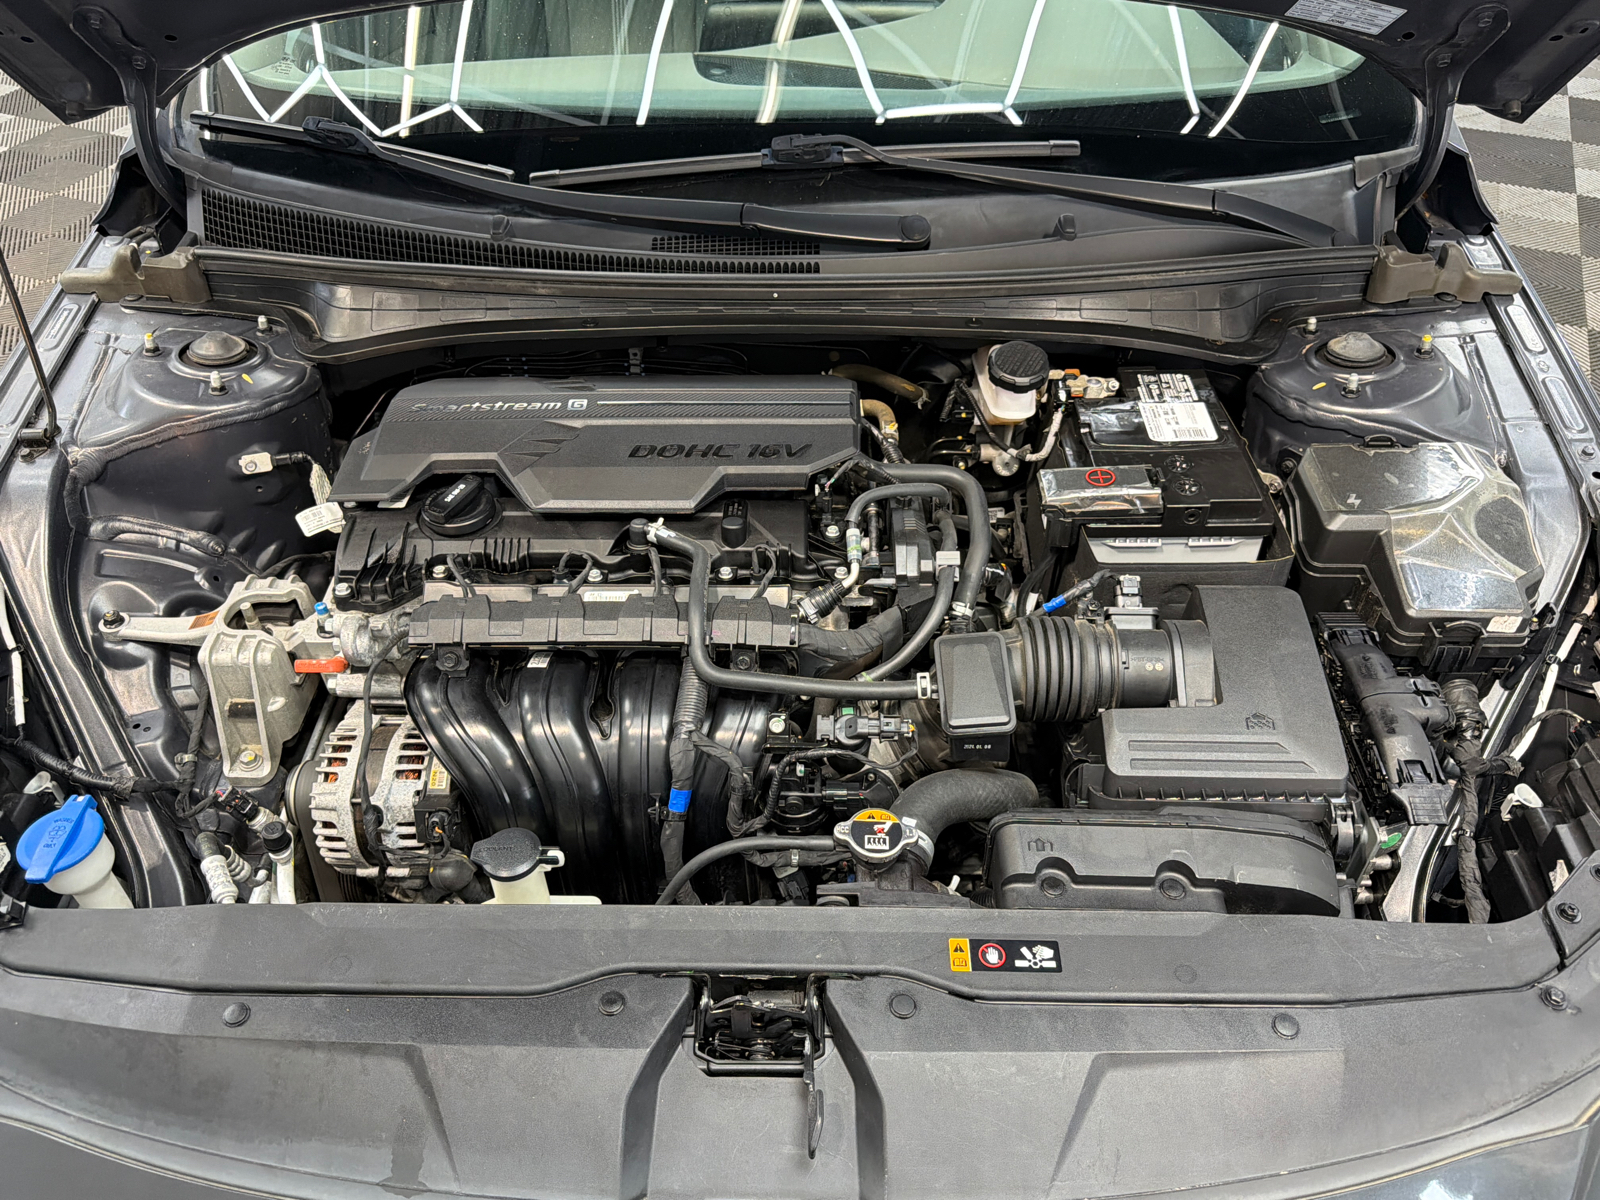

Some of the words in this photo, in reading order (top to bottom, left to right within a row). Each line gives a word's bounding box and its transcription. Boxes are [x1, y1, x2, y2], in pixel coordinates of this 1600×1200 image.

[411, 401, 562, 413] Smartstream
[628, 443, 741, 460] DOHC
[747, 443, 813, 459] 16V
